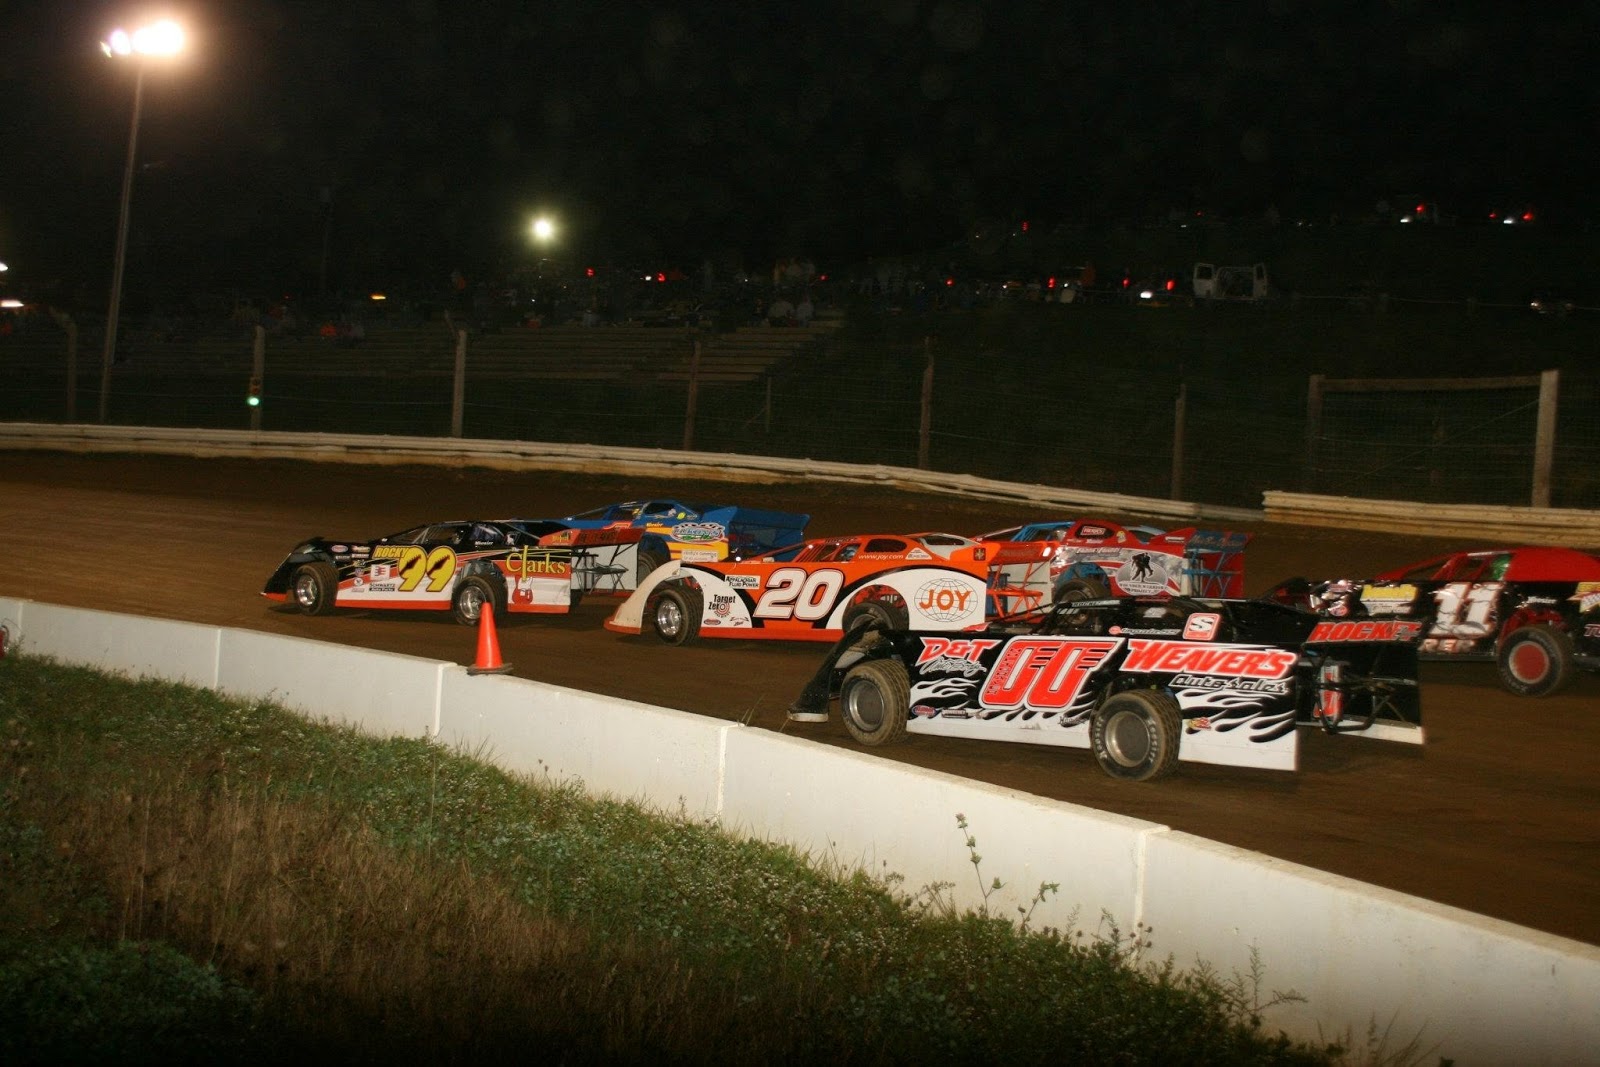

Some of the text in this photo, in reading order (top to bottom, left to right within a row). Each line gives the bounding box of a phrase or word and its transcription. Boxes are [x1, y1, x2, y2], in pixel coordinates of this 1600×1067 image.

[373, 546, 407, 559] ROCKY
[398, 545, 457, 592] 99
[506, 545, 566, 582] Clarks
[713, 594, 736, 604] Target
[753, 566, 844, 621] 20
[919, 589, 972, 612] JOY
[1428, 582, 1504, 638] 11
[915, 637, 1003, 667] D&T
[1119, 639, 1298, 680] WEAVER'S
[978, 635, 1126, 713] 00
